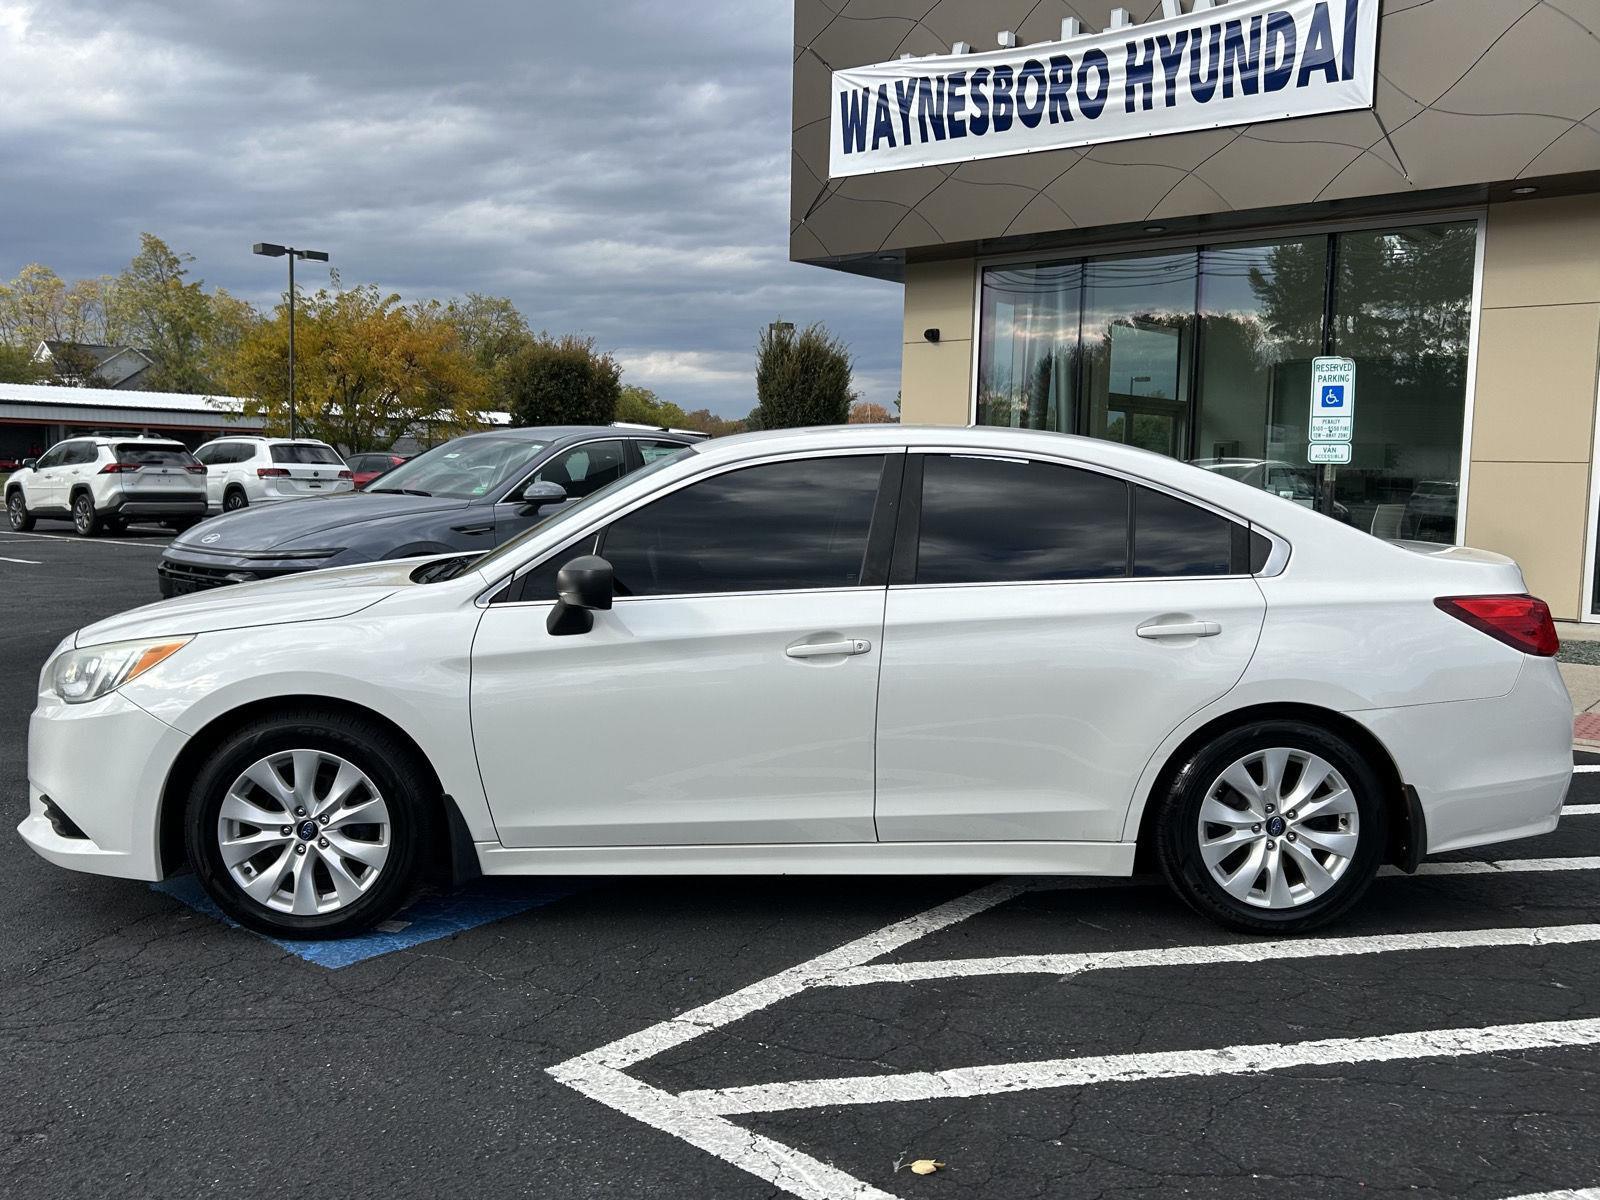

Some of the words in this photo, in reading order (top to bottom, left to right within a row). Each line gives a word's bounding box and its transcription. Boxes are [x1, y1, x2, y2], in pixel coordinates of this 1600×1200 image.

[840, 47, 1110, 154] WAYNESBORO
[1124, 0, 1358, 113] HYUNDAI
[1315, 363, 1353, 372] RESERVED
[1317, 374, 1350, 382] PARKING
